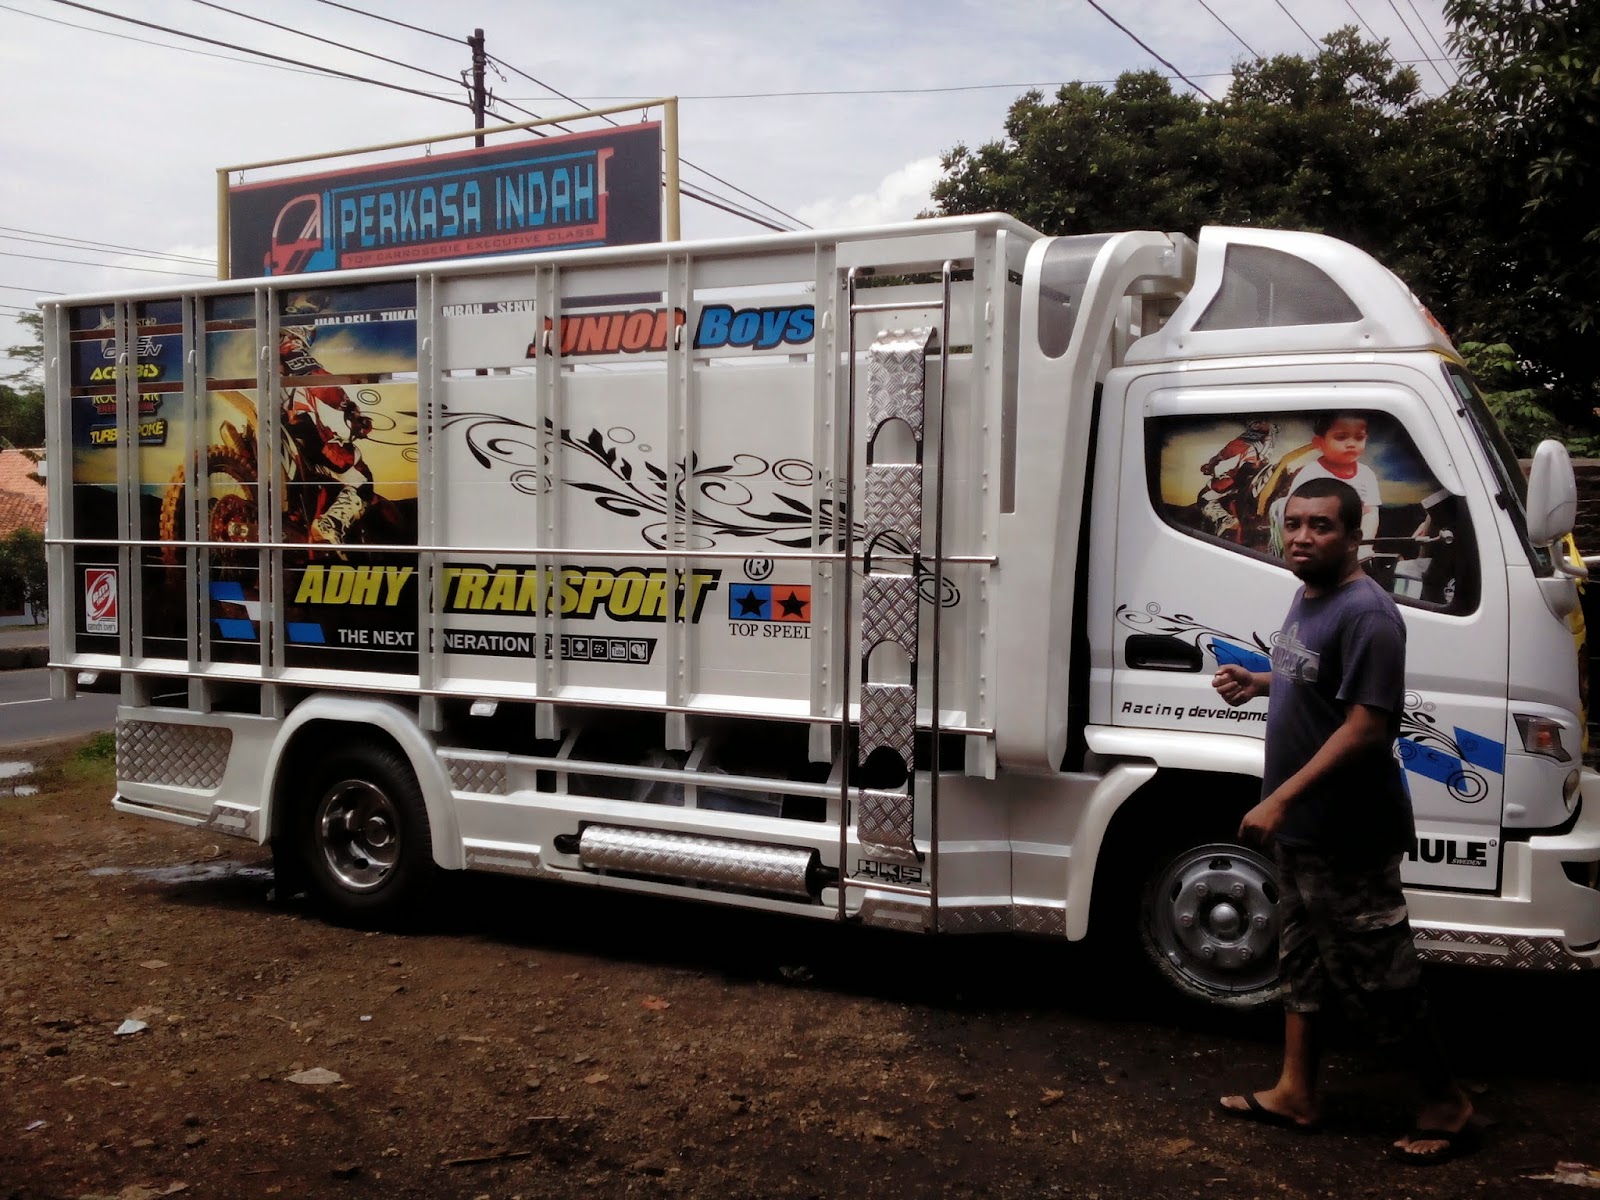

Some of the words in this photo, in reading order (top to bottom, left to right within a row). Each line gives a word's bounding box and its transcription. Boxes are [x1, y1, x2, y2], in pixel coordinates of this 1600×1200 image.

[341, 181, 481, 249] PERKASA
[496, 163, 593, 230] INDAH
[377, 243, 460, 261] CARROSERIE
[466, 233, 539, 251] EXECUTIVE
[548, 227, 594, 241] CLASS
[381, 308, 417, 321] TUKA
[442, 303, 483, 317] MBAH
[497, 300, 536, 314] SERVI
[695, 304, 815, 350] Boys
[103, 344, 163, 358] OEN
[90, 421, 164, 444] TURBOKE
[294, 565, 414, 606] ADHY
[432, 567, 716, 617] TRANSPORT
[338, 628, 369, 644] THE
[373, 630, 415, 647] NEXT
[440, 633, 530, 652] NERATION
[729, 622, 759, 637] TOP
[1121, 701, 1184, 720] Racing
[1188, 705, 1267, 722] developme
[1405, 838, 1488, 867] HULE
[1450, 857, 1483, 867] SWEDEN
[858, 859, 922, 883] HKS
